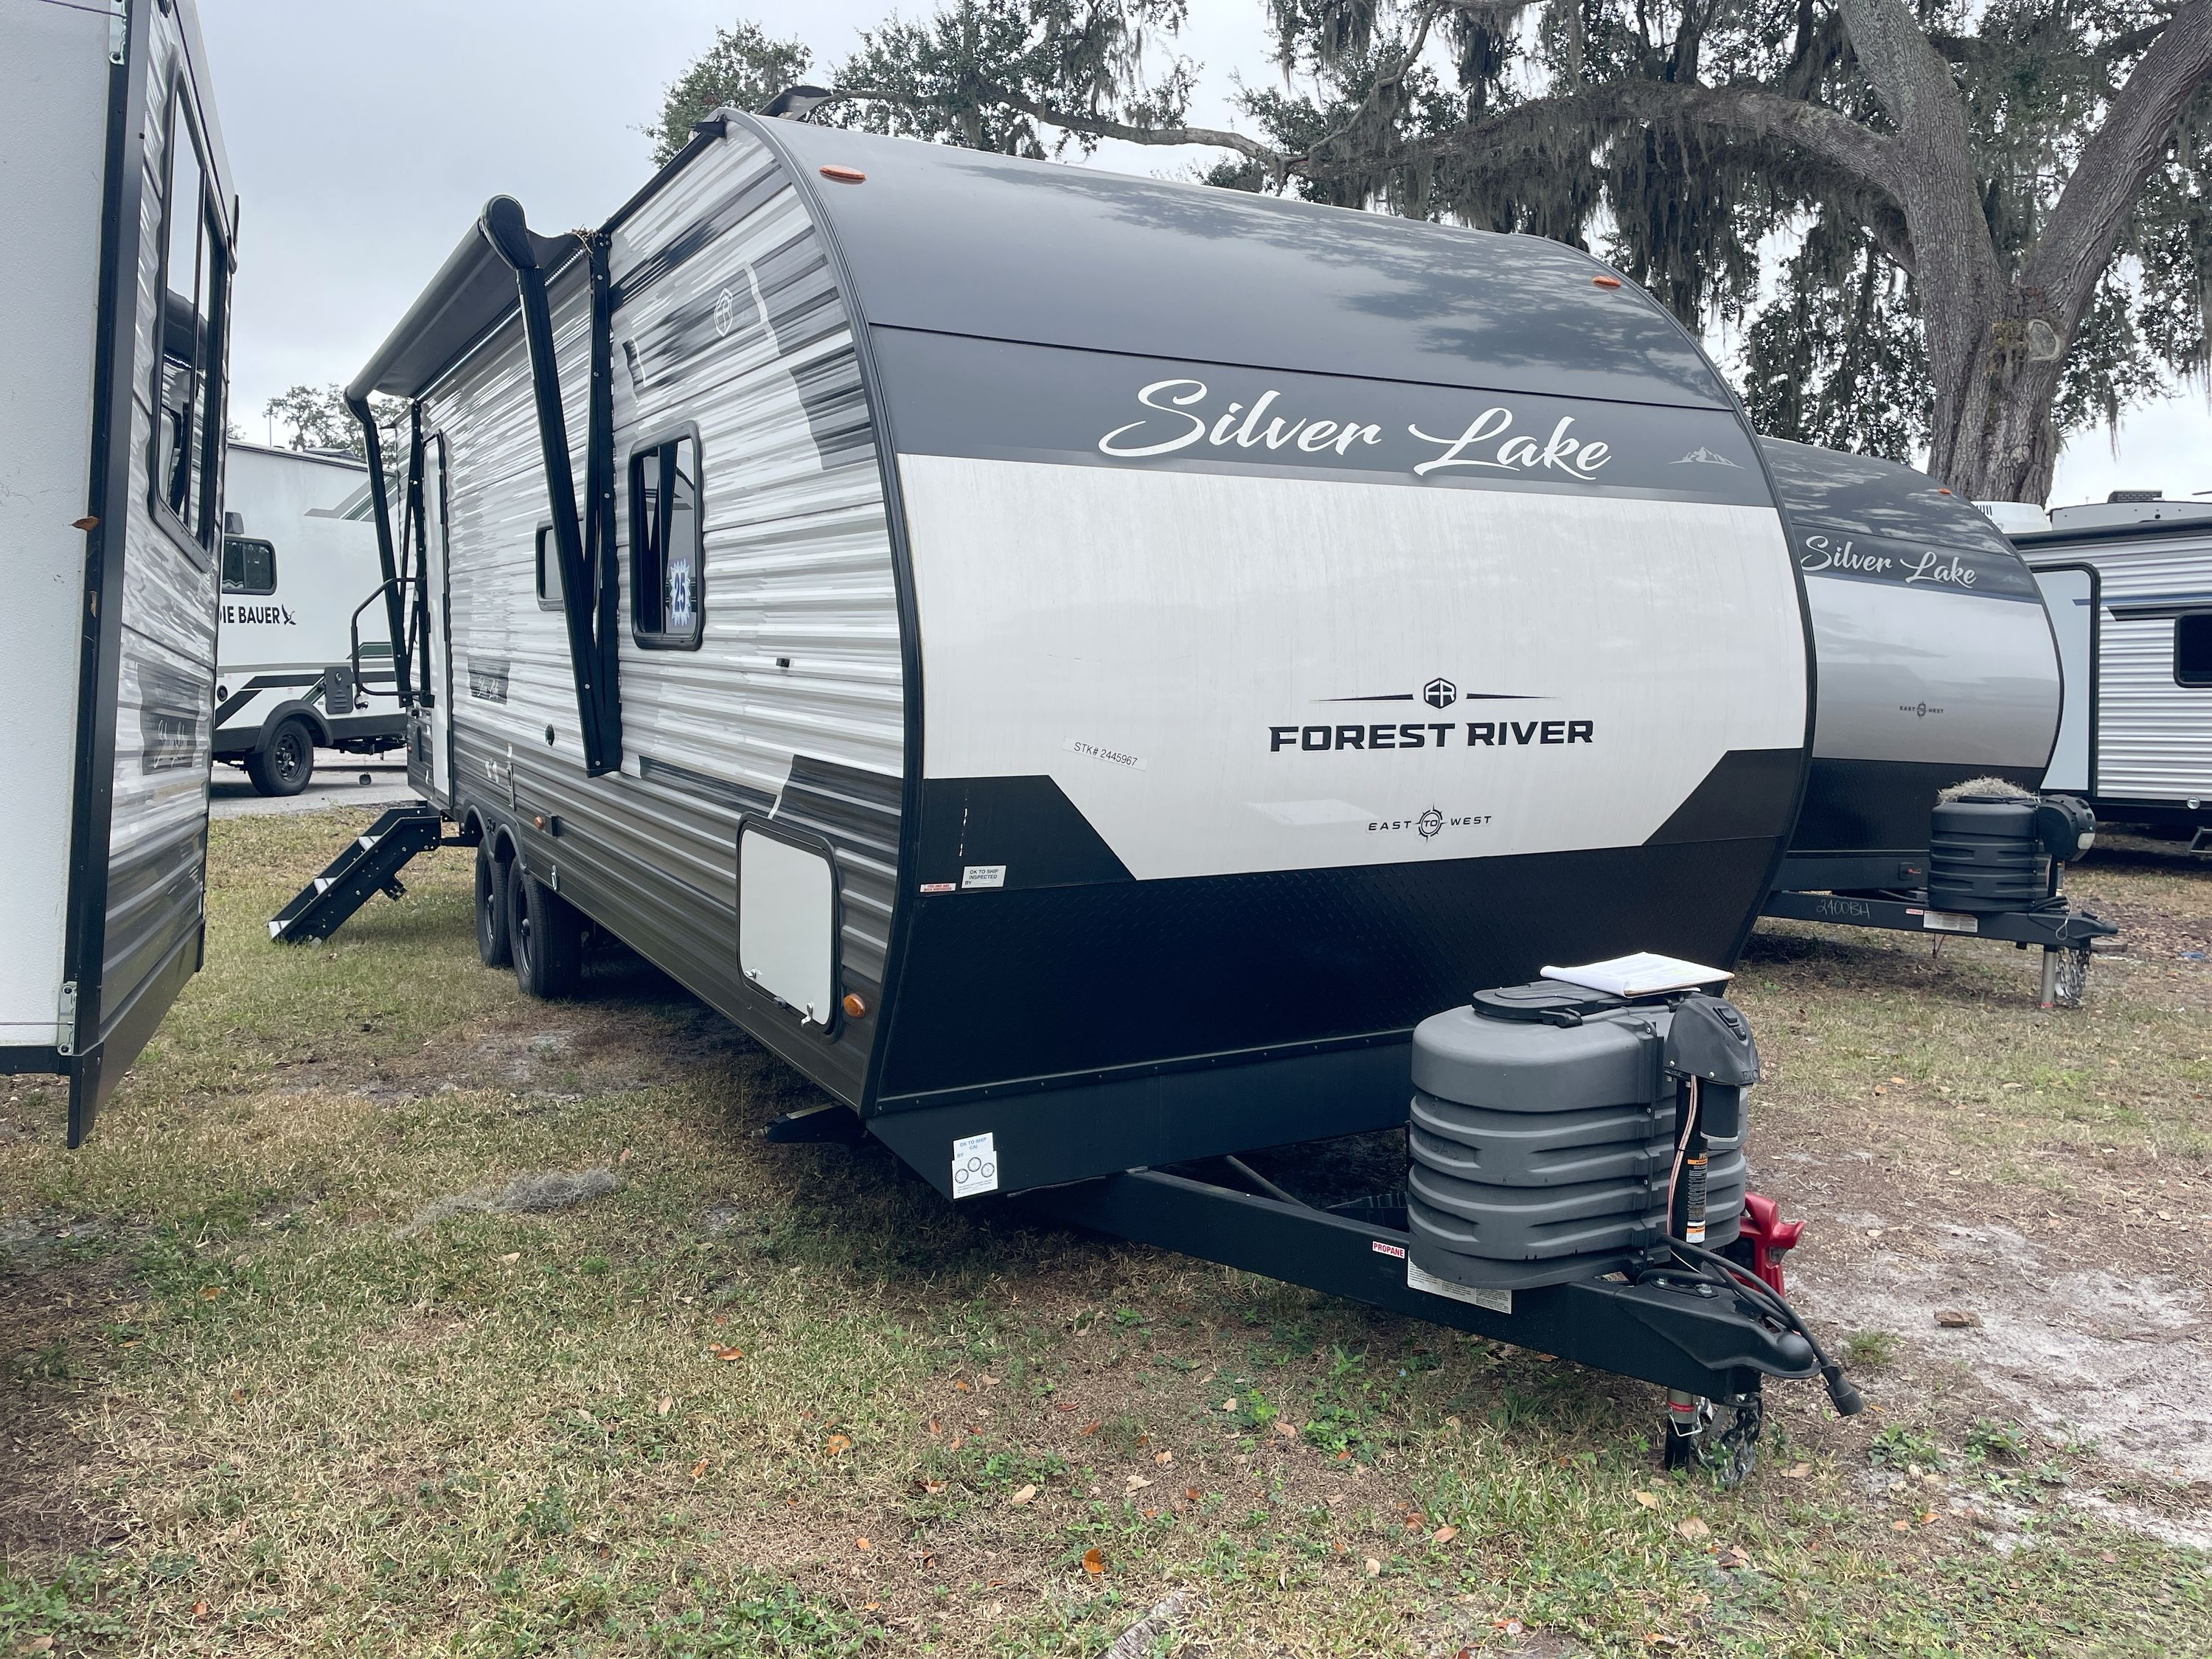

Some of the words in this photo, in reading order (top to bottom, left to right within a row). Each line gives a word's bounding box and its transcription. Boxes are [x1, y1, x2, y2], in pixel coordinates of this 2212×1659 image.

[1098, 378, 1382, 457] Silver
[1408, 407, 1612, 481] Lake
[1800, 535, 1893, 573] Silver
[1899, 552, 1977, 588] Lake
[674, 572, 686, 613] 25
[220, 605, 234, 624] IE
[238, 606, 280, 624] BAUER
[1267, 722, 1455, 752] FOREST
[1465, 720, 1594, 747] RIVER
[1074, 742, 1099, 756] STK#
[1100, 748, 1138, 766] 2445967
[1368, 820, 1413, 832] EAST
[1423, 819, 1439, 827] TO
[1450, 815, 1492, 826] WEST
[1816, 899, 1871, 919] 2400BH
[1373, 1242, 1404, 1258] PROPANE
